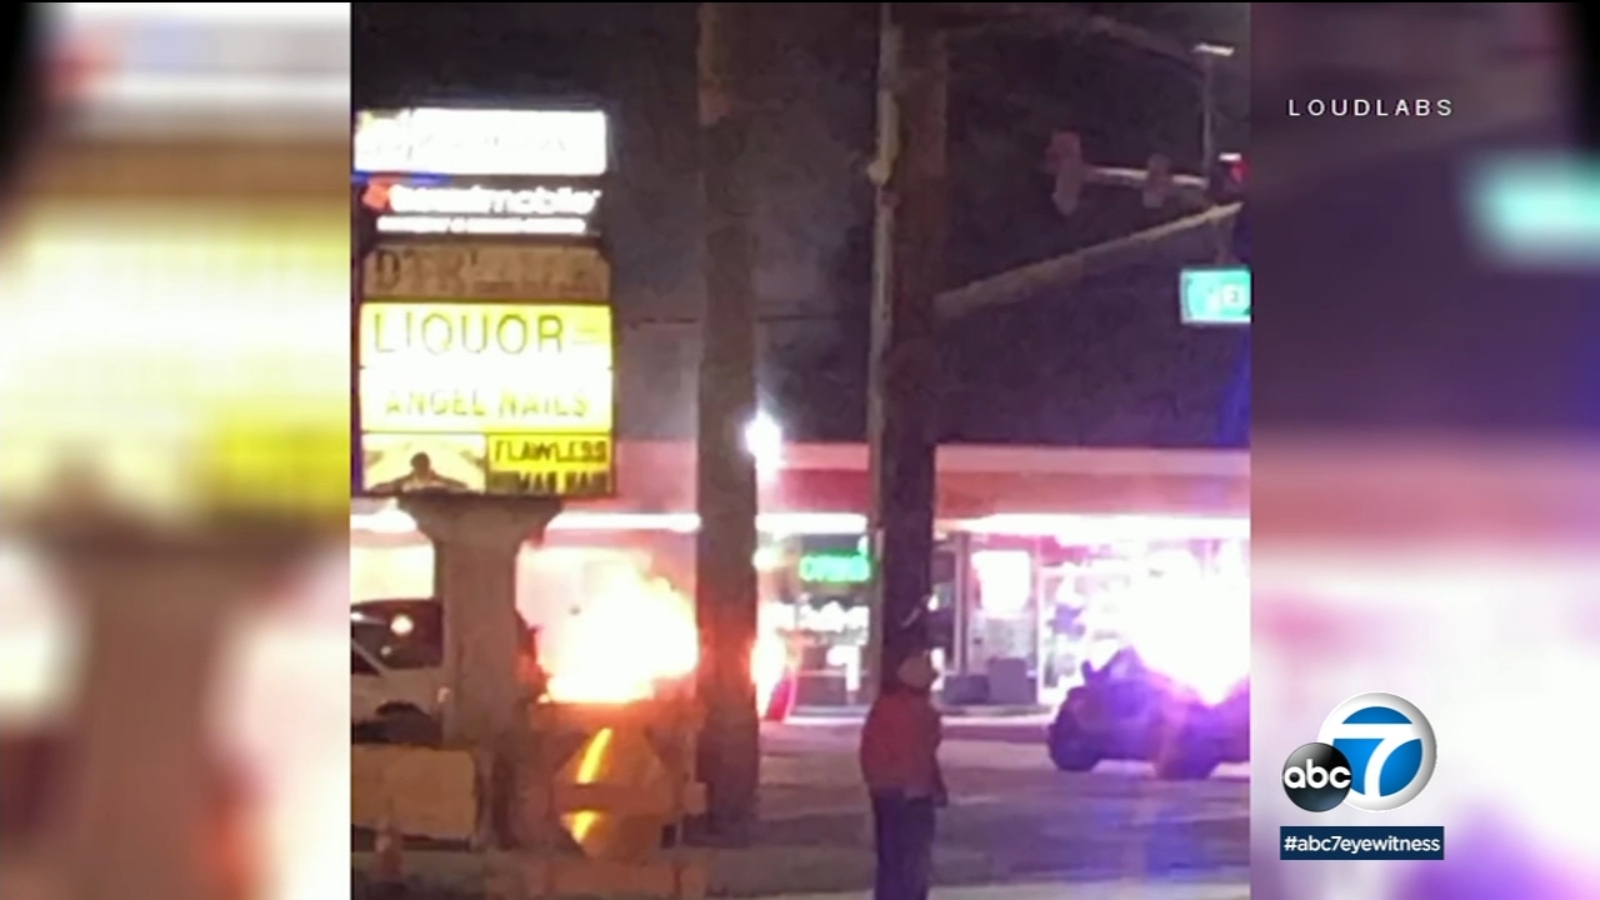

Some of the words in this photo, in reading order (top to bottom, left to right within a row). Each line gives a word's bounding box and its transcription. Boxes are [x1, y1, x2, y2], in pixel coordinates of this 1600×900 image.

[373, 311, 564, 355] LIQUOR
[385, 389, 486, 417] ANGEL
[498, 389, 587, 418] NAILS
